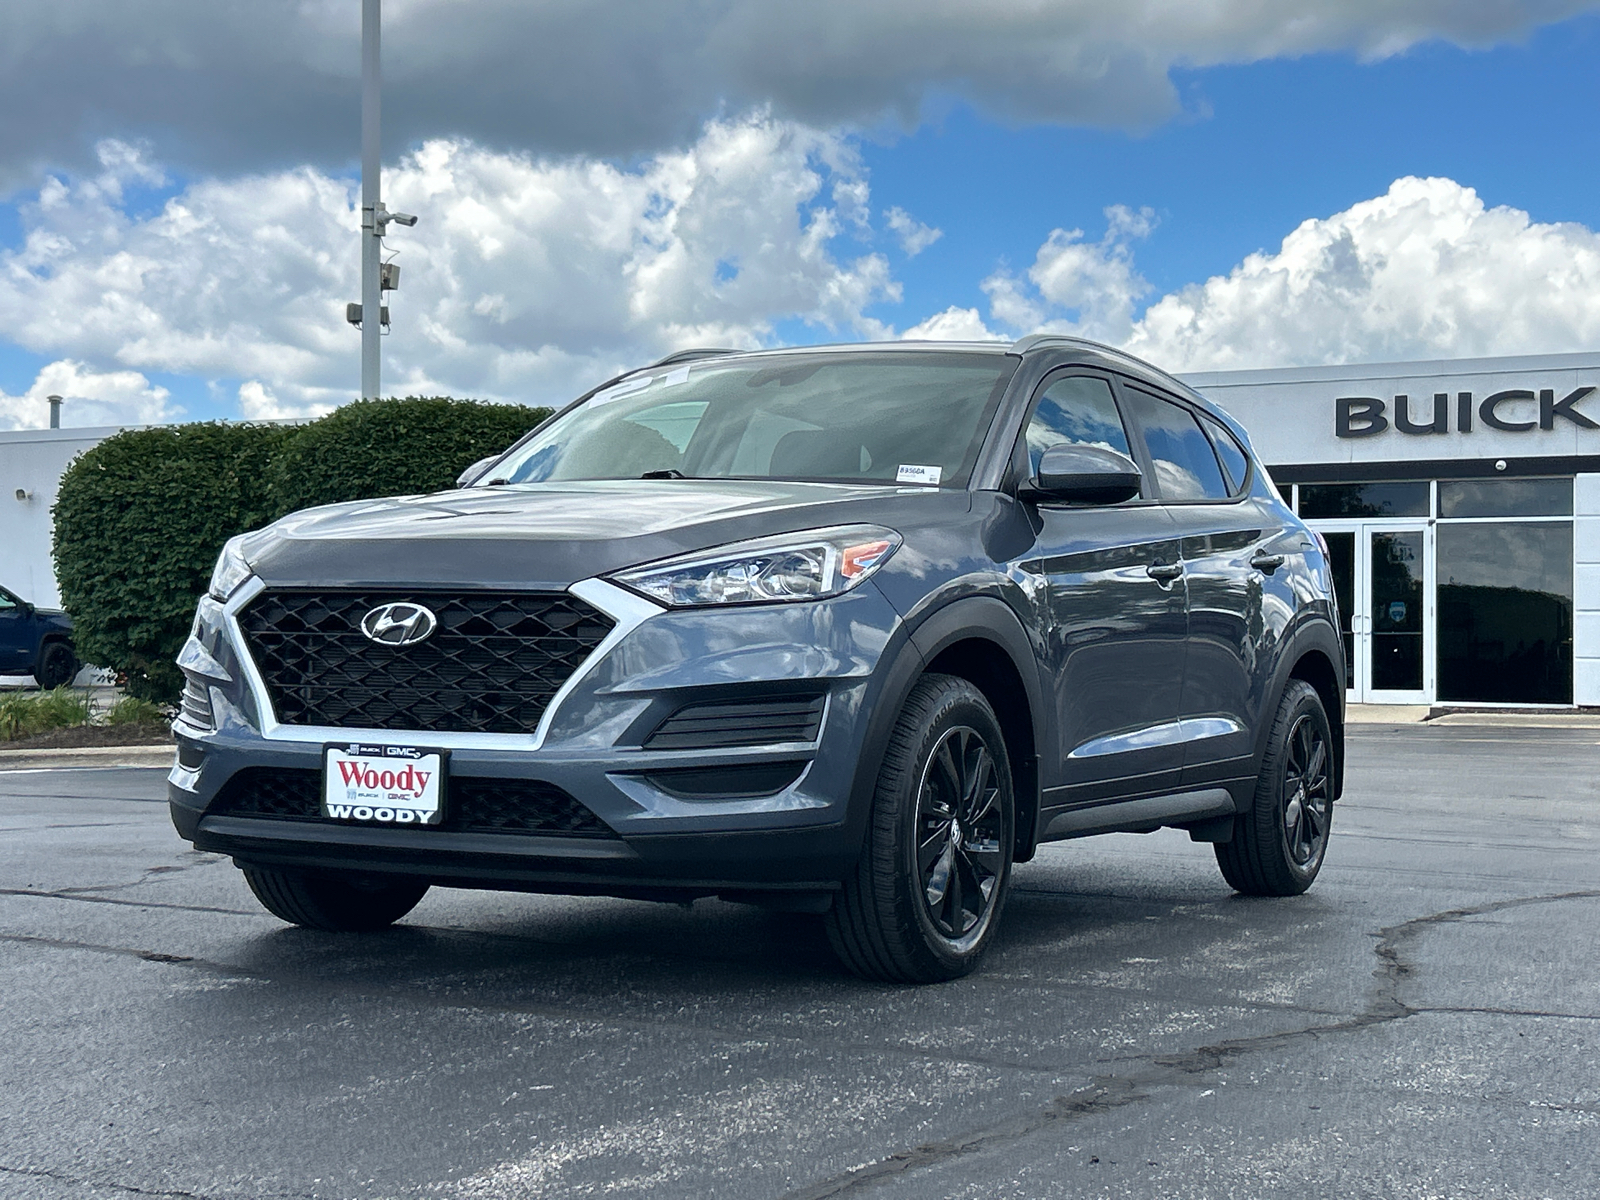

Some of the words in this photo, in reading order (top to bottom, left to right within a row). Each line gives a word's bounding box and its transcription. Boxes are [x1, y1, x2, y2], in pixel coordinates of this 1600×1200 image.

[1335, 386, 1600, 437] BUICK
[387, 747, 416, 756] GMC
[336, 760, 432, 798] Woody
[387, 793, 411, 801] GMC
[327, 804, 434, 824] WOODY
